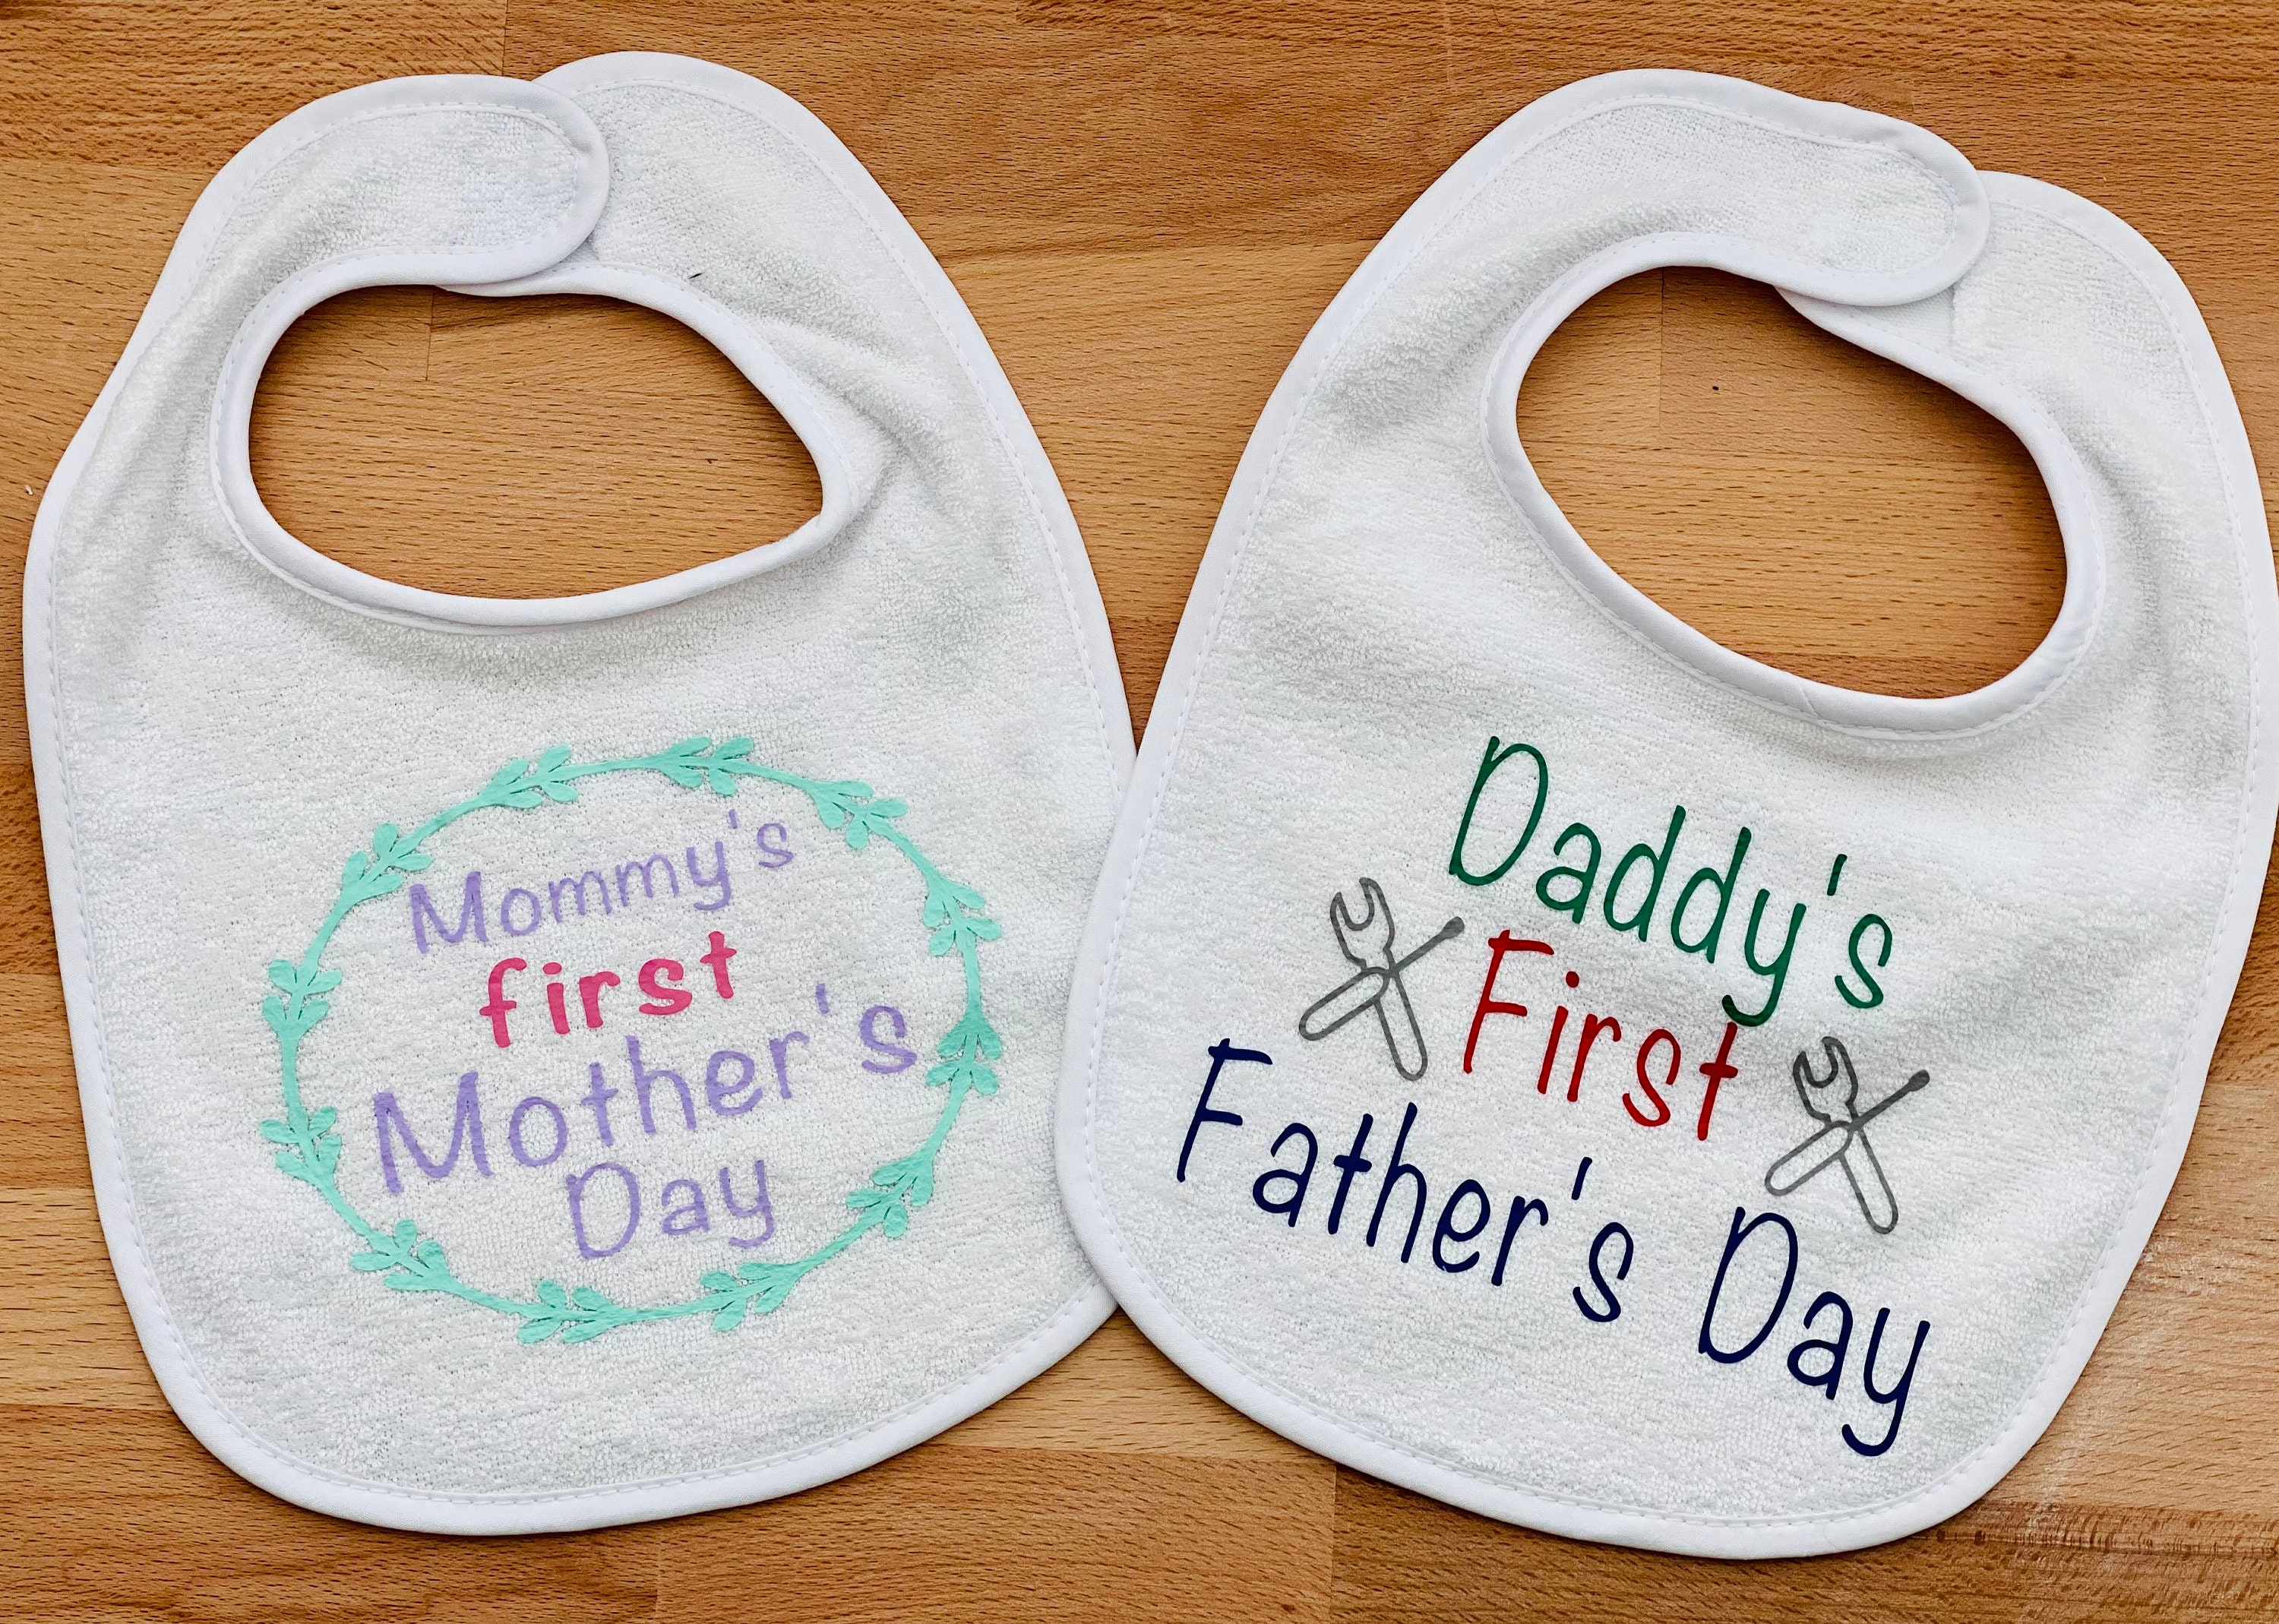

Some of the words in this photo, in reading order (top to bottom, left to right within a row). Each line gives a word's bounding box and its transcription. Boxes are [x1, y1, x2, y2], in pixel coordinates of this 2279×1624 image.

[409, 809, 795, 954] Mommy's
[1448, 735, 1894, 1027] Daddy's
[372, 984, 918, 1194] Mother's
[479, 930, 738, 1049] first
[1462, 928, 1740, 1142] First
[564, 1158, 776, 1260] Day
[1176, 1038, 1635, 1322] Father's
[1698, 1205, 1931, 1457] Day
